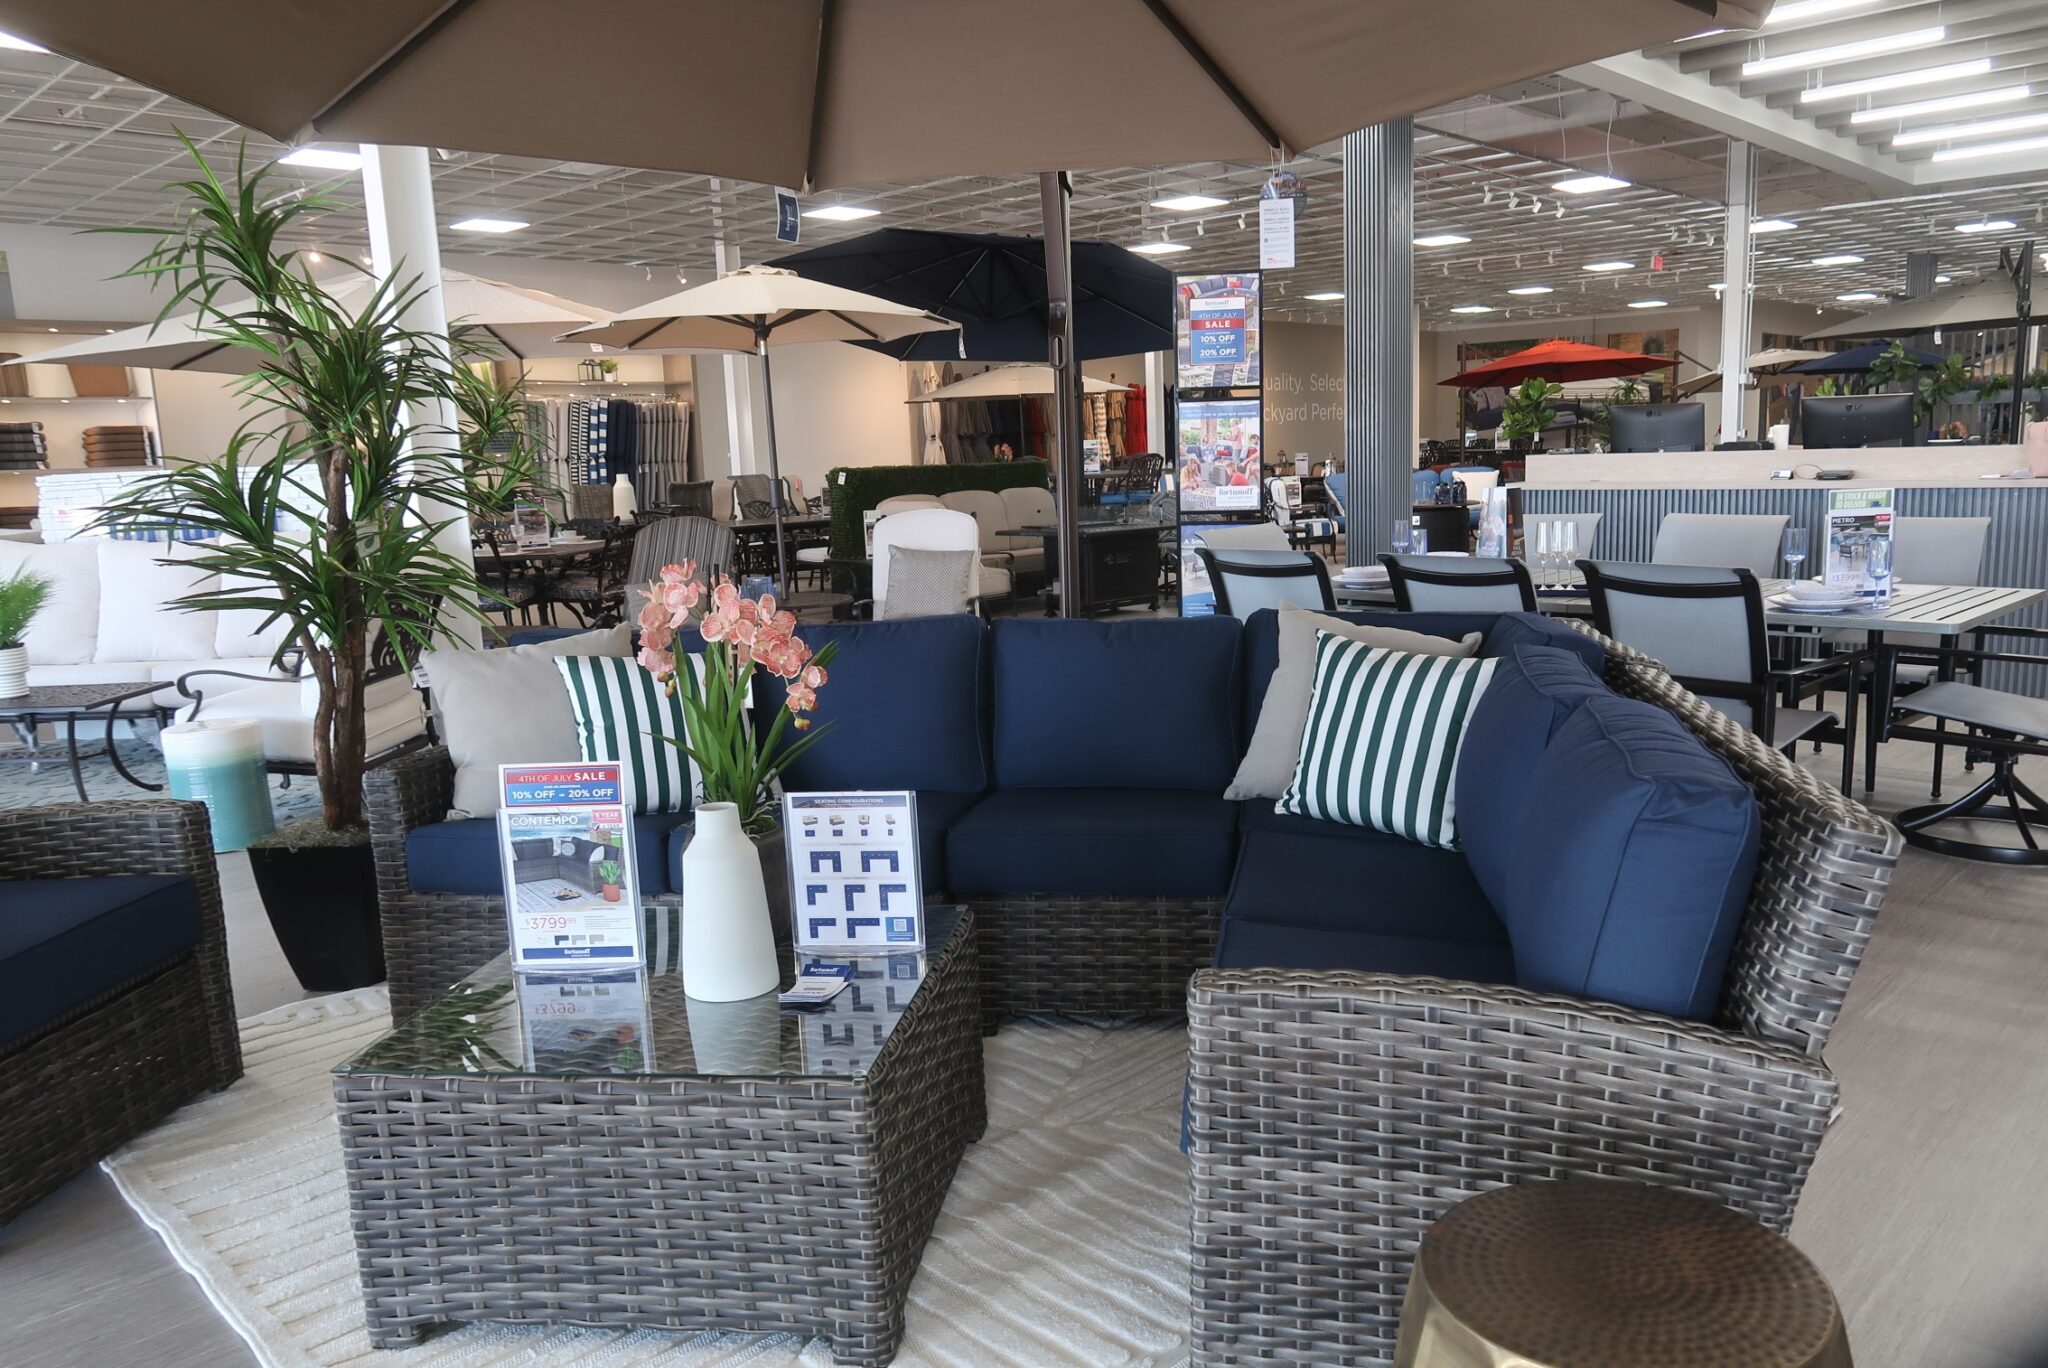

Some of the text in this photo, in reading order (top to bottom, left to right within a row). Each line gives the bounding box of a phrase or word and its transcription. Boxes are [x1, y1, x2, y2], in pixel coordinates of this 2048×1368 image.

[1204, 320, 1231, 328] SALE
[1200, 334, 1236, 343] 10% OFF
[1219, 348, 1237, 356] OFF
[1265, 373, 1304, 395] uality.
[1263, 402, 1344, 425] ckyard Perfe
[1844, 492, 1861, 500] STOCK
[1867, 490, 1888, 500] READY
[1843, 500, 1867, 509] DELIVER
[518, 771, 606, 783] 4TH OF JULY SALE
[512, 790, 532, 799] 10%
[534, 790, 556, 799] OFF
[568, 789, 590, 798] 20%
[592, 788, 614, 797] OFF
[511, 815, 578, 826] CONTEMPO
